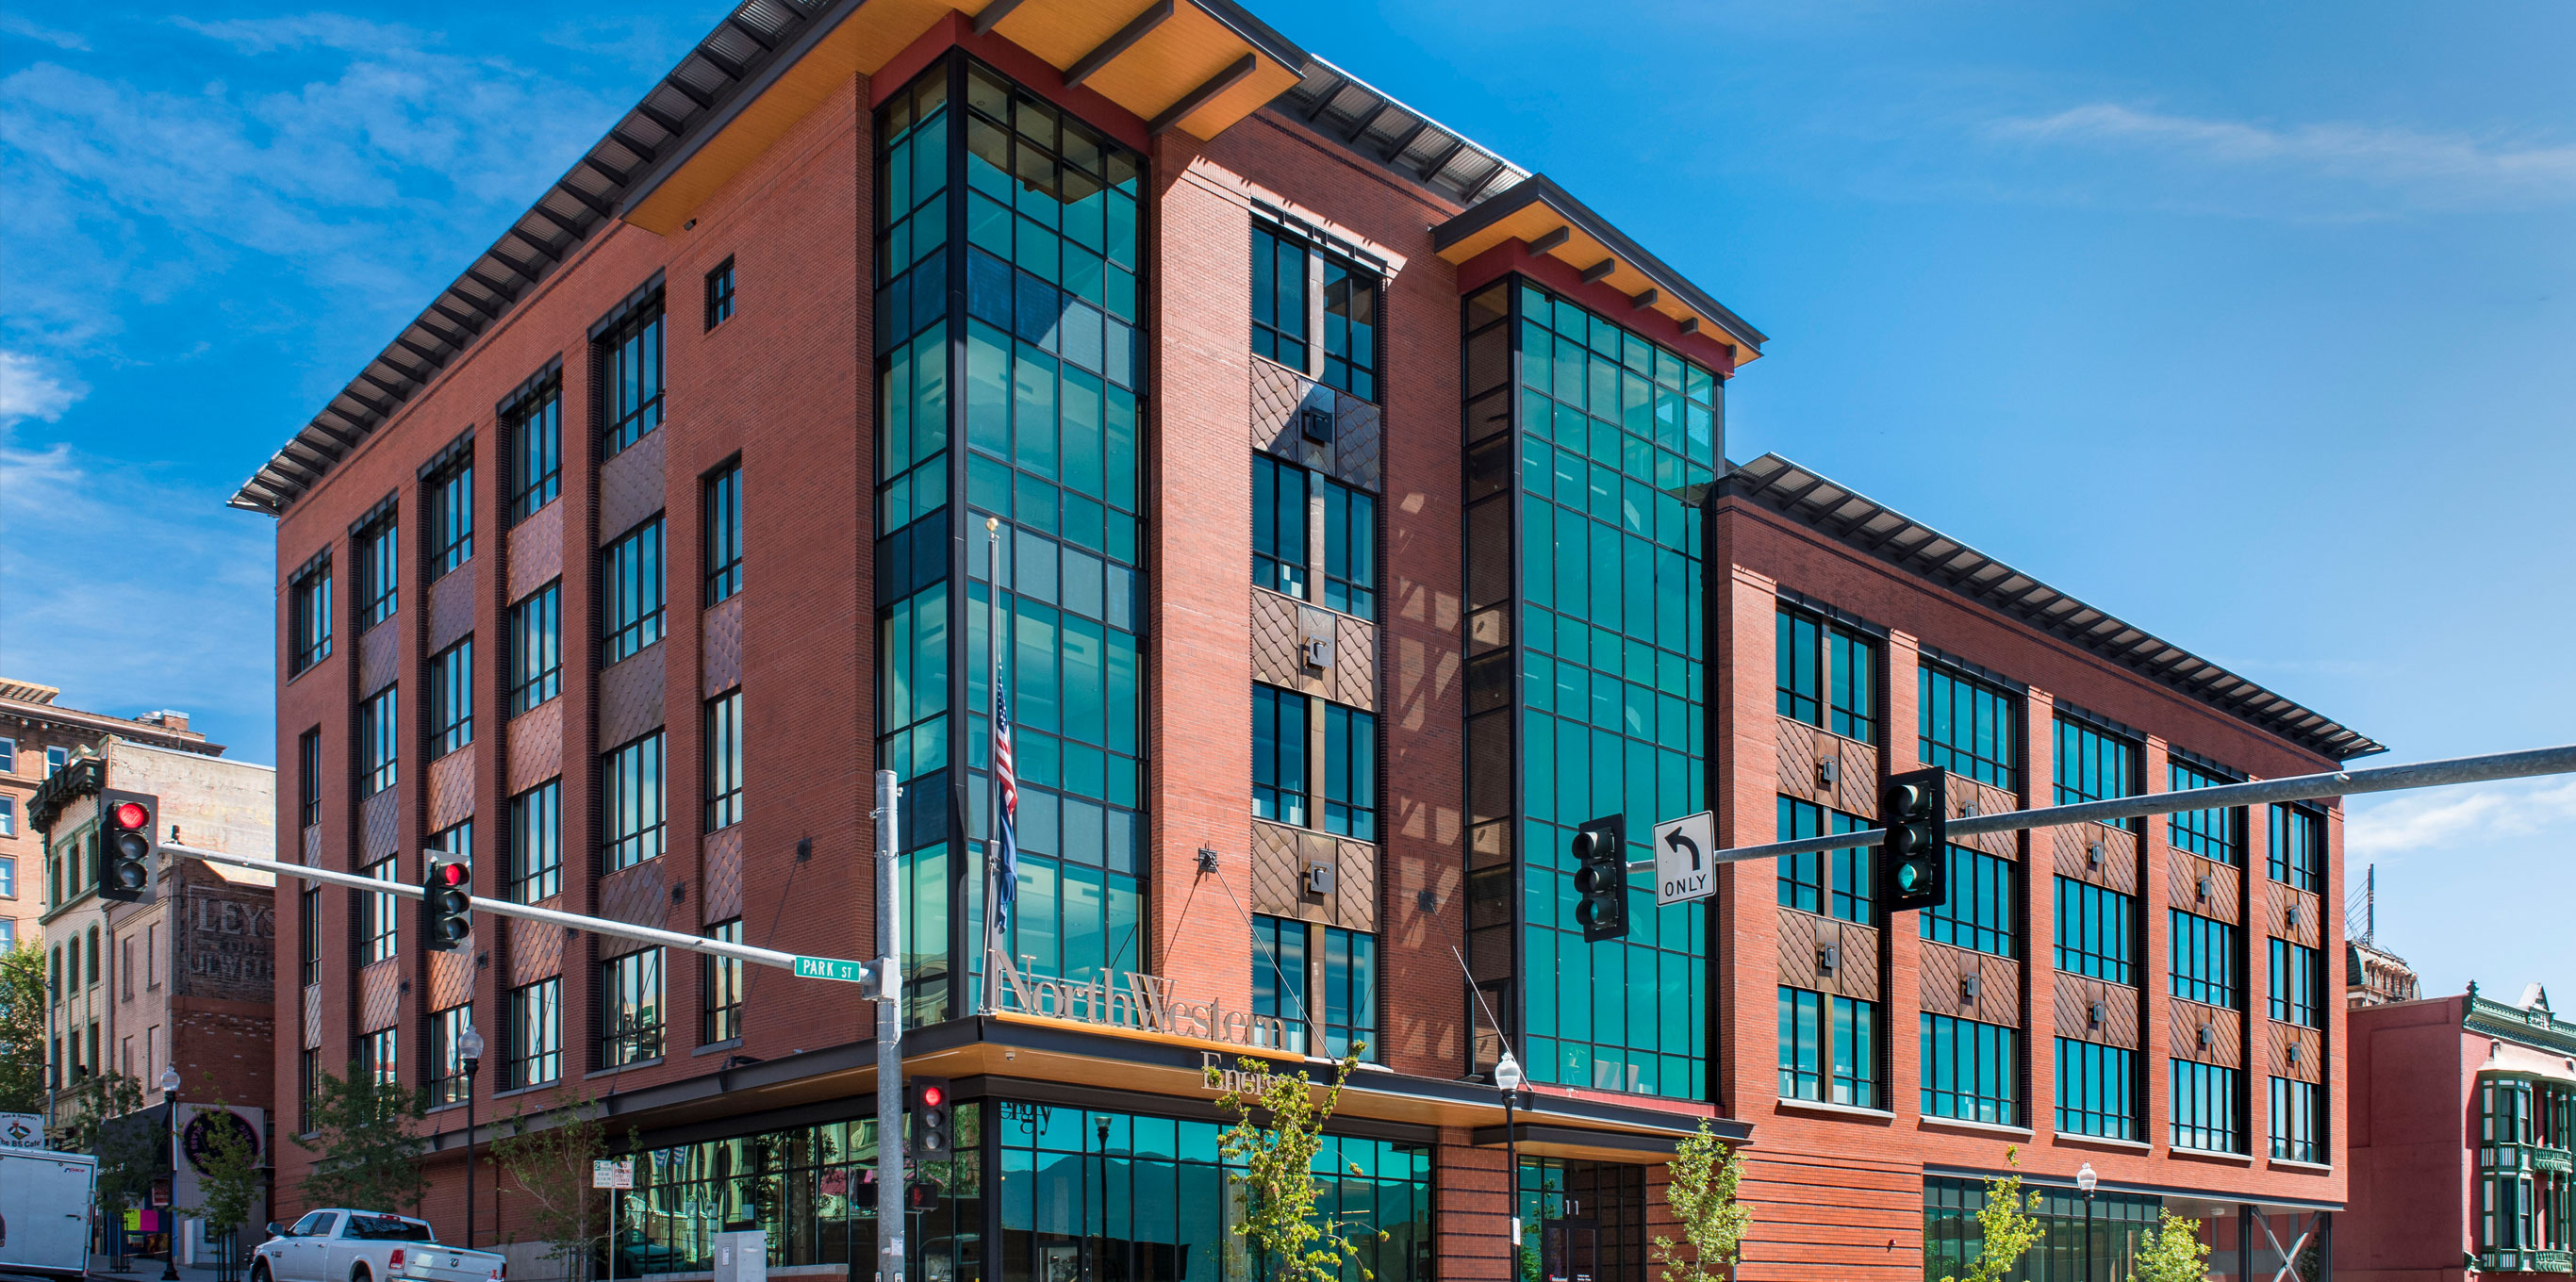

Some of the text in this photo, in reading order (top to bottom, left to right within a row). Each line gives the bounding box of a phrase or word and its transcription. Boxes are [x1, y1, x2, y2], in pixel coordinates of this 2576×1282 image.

[1664, 873, 1707, 896] ONLY
[802, 959, 852, 978] PARK ST
[988, 948, 1291, 1051] NorthWestern
[1200, 1050, 1301, 1111] Ener
[0, 1137, 10, 1146] he
[1565, 1199, 1579, 1215] 11
